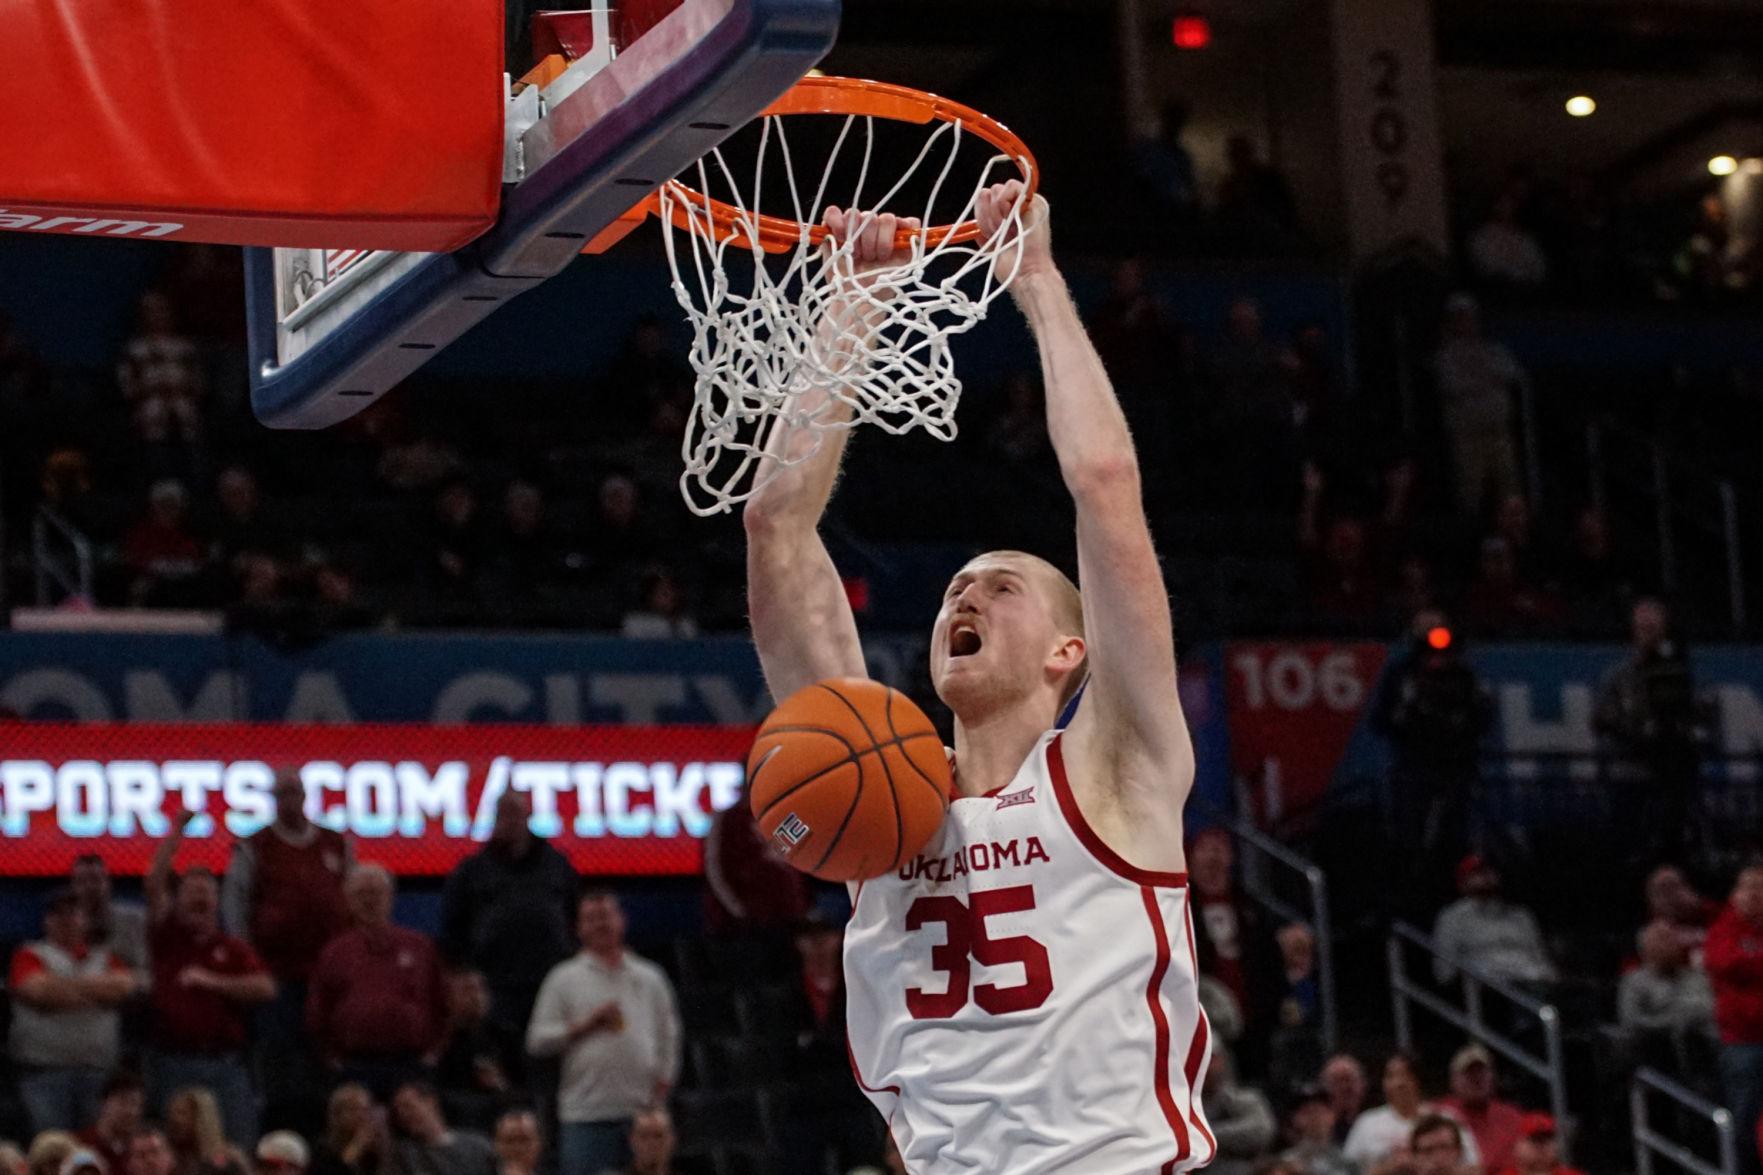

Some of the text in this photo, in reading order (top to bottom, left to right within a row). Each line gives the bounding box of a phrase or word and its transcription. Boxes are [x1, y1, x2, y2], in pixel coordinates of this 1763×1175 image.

[0, 209, 184, 237] arm
[1233, 651, 1364, 711] 106
[898, 836, 1051, 882] OKLAOMA
[905, 884, 1054, 1020] 35
